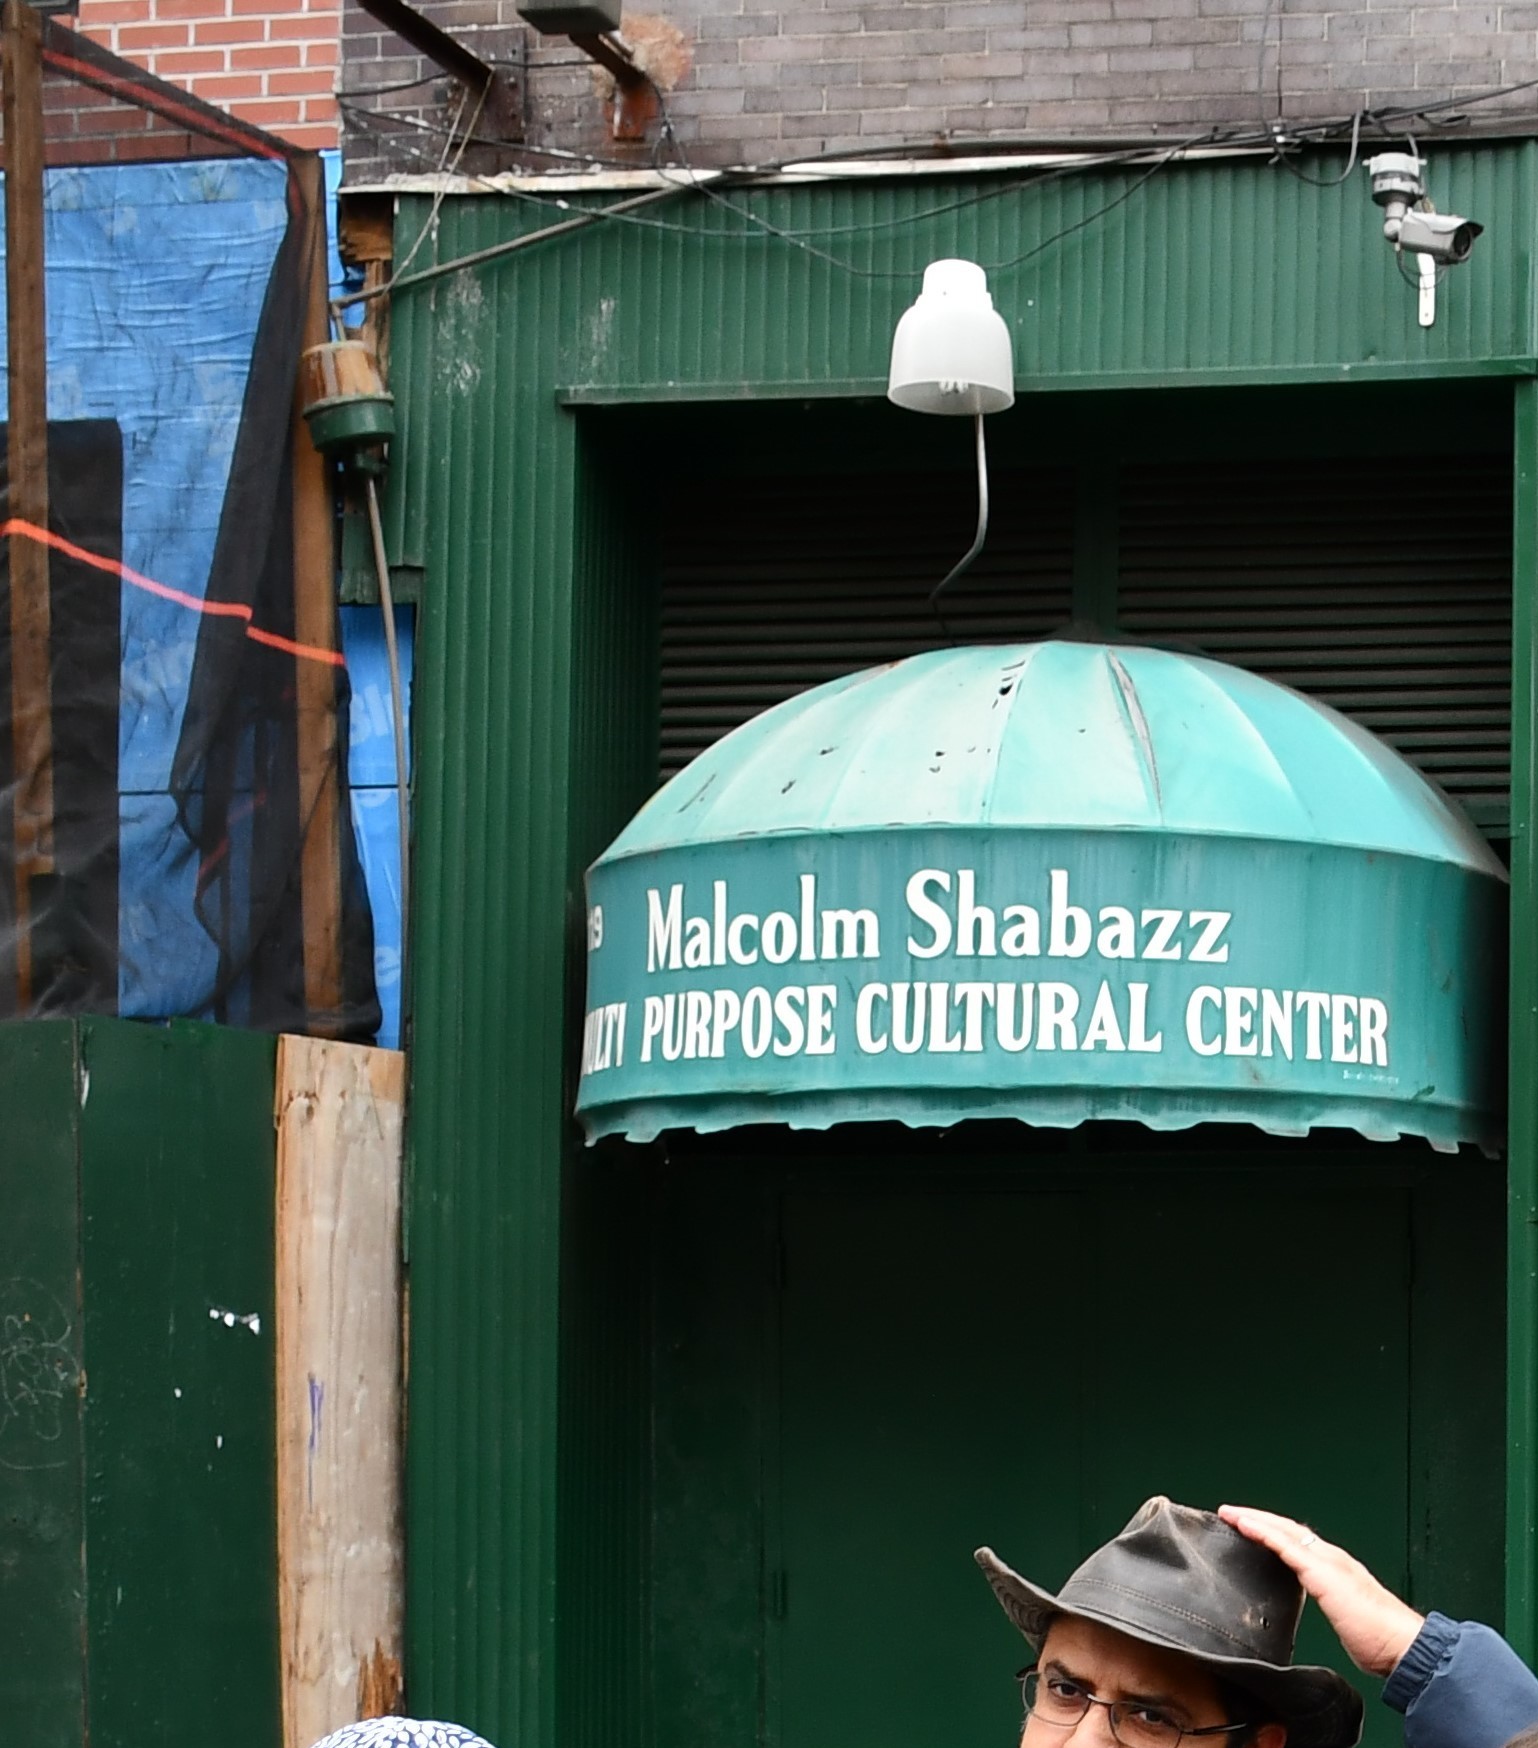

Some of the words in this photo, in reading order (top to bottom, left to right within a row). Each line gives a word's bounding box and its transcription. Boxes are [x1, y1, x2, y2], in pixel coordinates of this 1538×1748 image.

[646, 873, 880, 974] Malcolm
[905, 868, 1232, 963] Shabazz
[640, 983, 838, 1063] PURPOSE
[855, 979, 1163, 1055] CULTURAL
[1185, 985, 1390, 1067] CENTER
